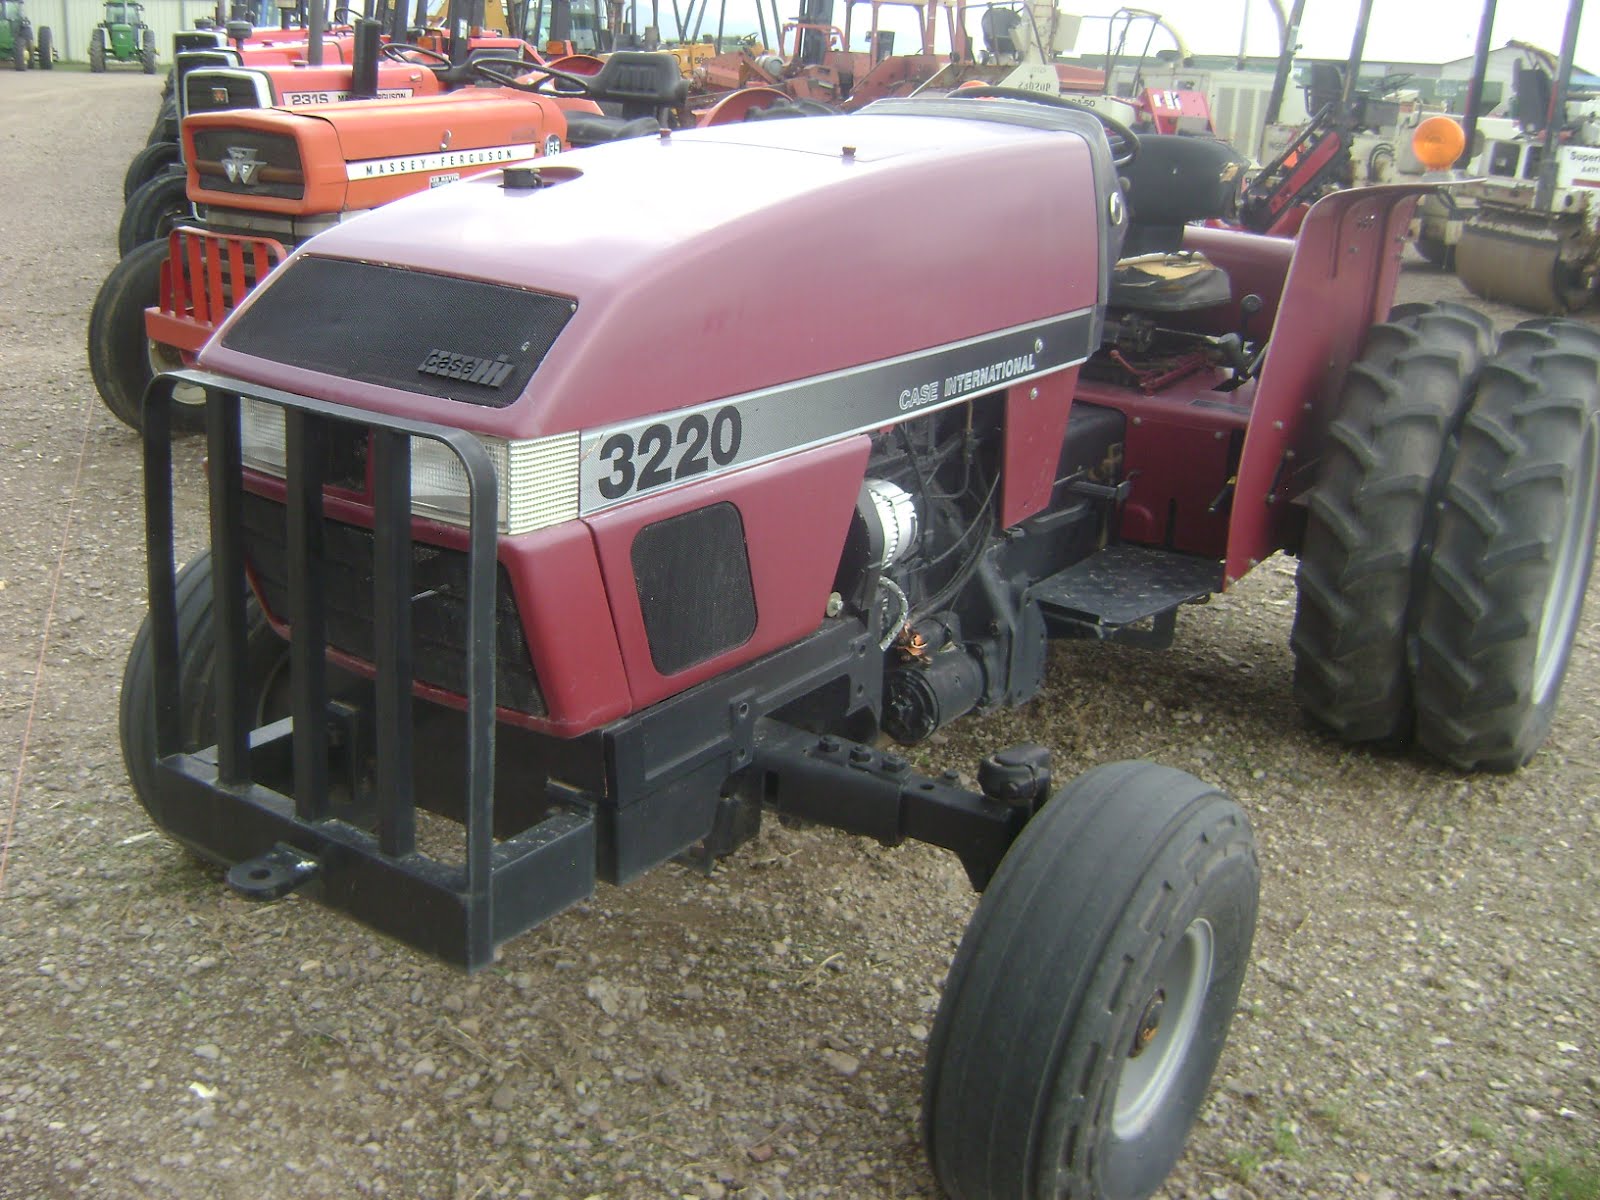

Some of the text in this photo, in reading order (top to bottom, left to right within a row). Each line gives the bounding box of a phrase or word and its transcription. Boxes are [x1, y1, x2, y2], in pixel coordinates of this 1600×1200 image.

[899, 353, 1035, 410] CASE INTERNATIONAL
[598, 405, 742, 500] 3220
